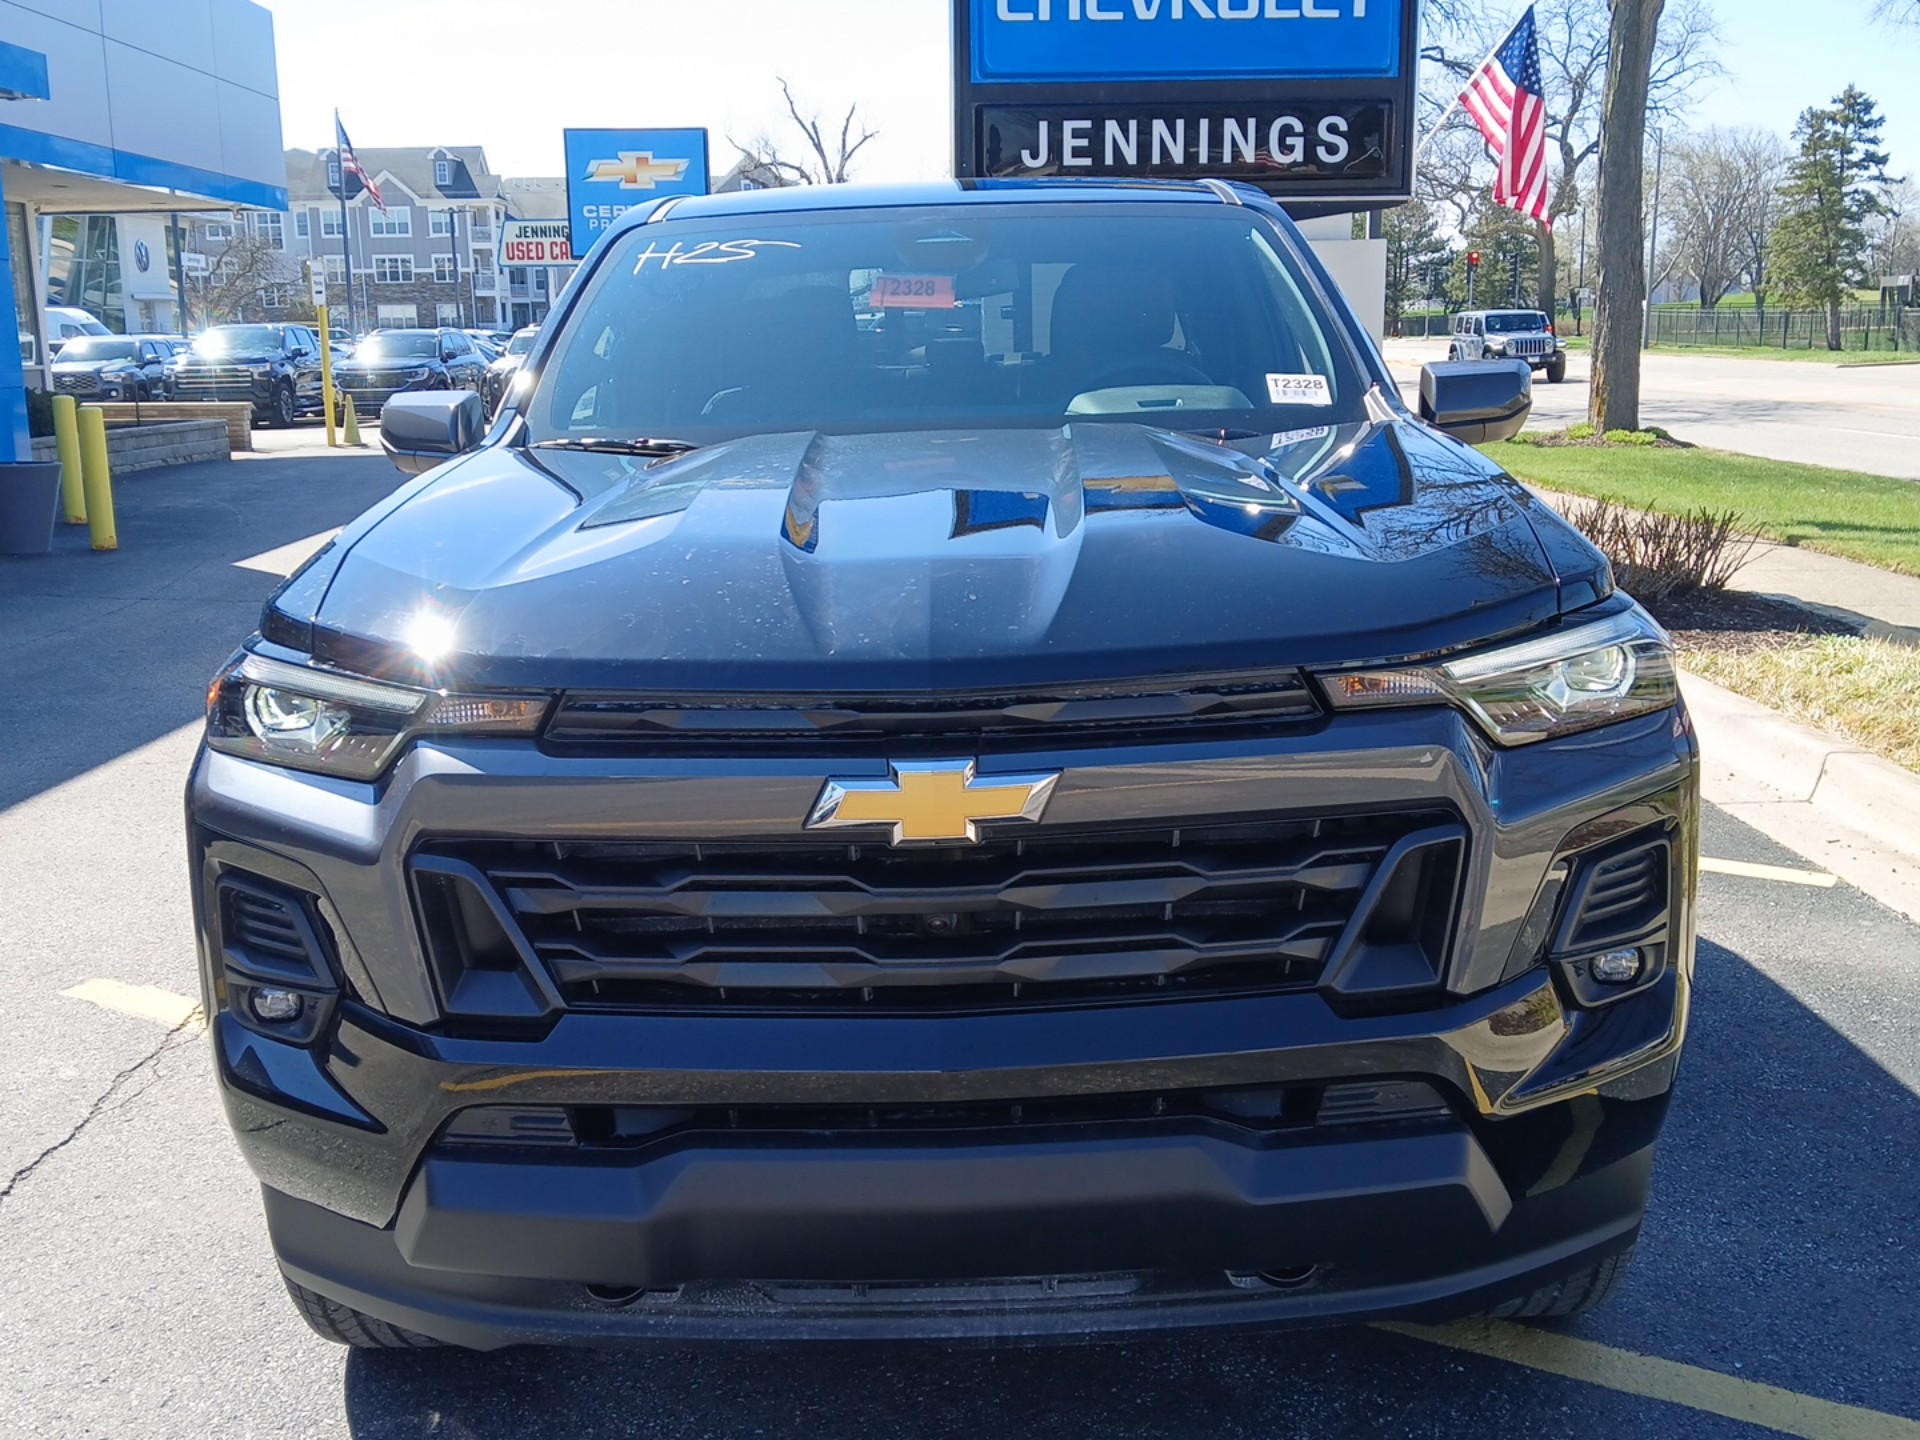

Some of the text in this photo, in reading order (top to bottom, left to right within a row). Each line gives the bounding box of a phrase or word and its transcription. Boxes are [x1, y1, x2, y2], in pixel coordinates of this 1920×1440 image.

[1020, 115, 1350, 169] JENNINGS
[505, 241, 545, 260] USED
[1270, 378, 1324, 390] T2328
